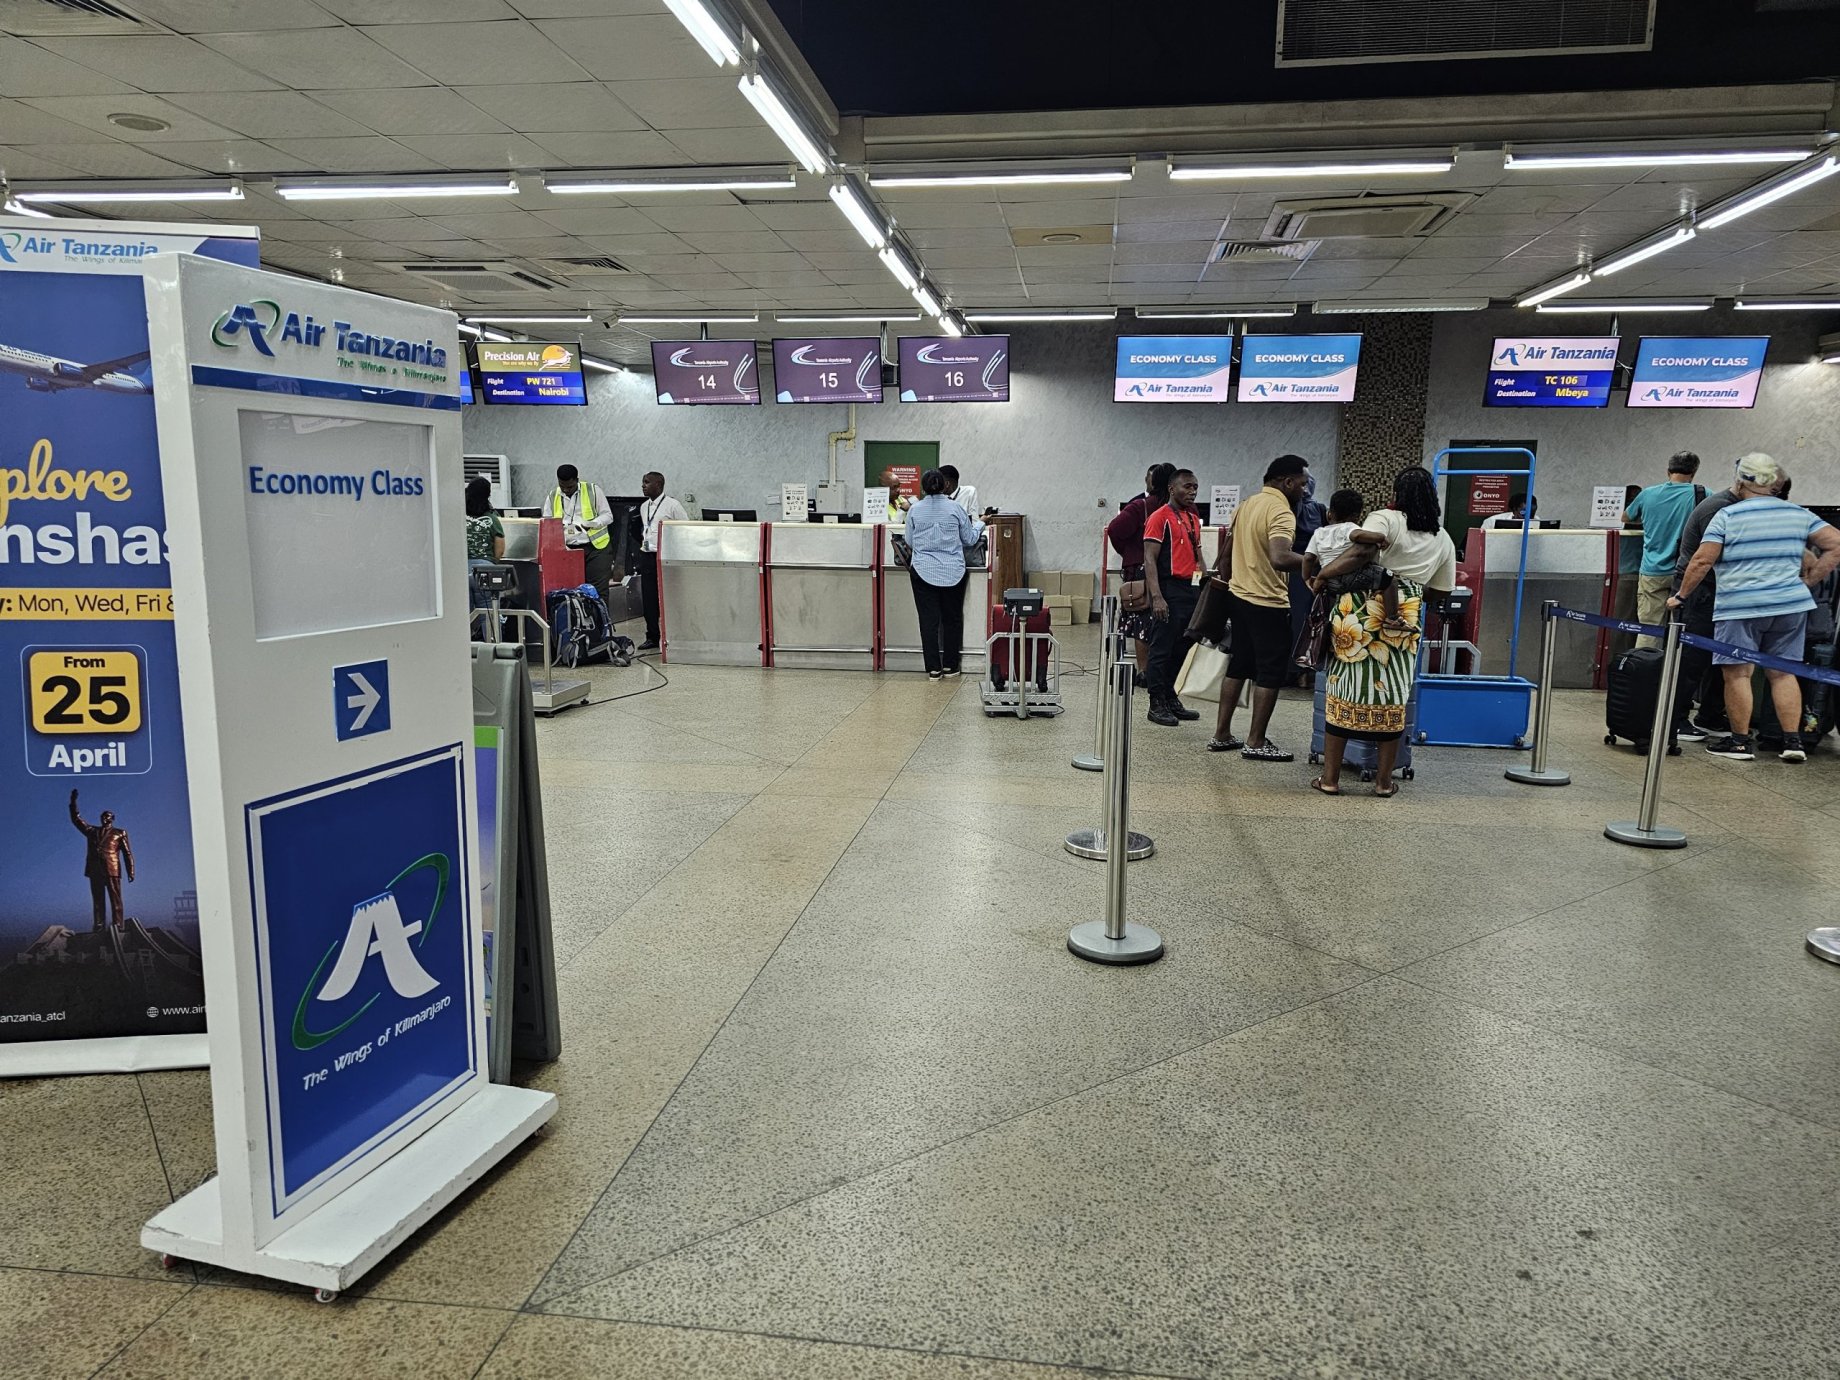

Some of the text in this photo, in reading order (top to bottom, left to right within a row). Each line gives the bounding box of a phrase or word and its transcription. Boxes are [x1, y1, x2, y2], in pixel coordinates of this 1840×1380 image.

[23, 237, 158, 257] Air Tanzania
[280, 311, 447, 369] Air Tanzania
[484, 351, 540, 361] Precision Air
[1255, 354, 1345, 363] ECONOMY CLASS
[1524, 346, 1616, 360] Air Tanzania
[1130, 355, 1217, 364] ECONOMY CLASS
[1651, 357, 1749, 366] ECONOMY CLASS
[487, 377, 556, 386] Flight PW 721
[698, 374, 717, 390] 14
[819, 372, 839, 388] 15
[944, 371, 964, 387] 16
[1494, 376, 1579, 387] Flight TC 106
[539, 388, 569, 396] Nairobi
[1147, 384, 1213, 393] Air Tanzania
[1272, 384, 1340, 393] Air Tanzania
[1555, 388, 1589, 399] Mbeya
[1665, 388, 1740, 397] Air Tanzania
[249, 466, 424, 501] Economy Class
[19, 594, 69, 615] Mon,
[75, 594, 130, 616] Wed,
[137, 594, 160, 611] Fri
[64, 656, 105, 668] From
[42, 675, 131, 725] 25
[48, 742, 126, 773] April
[303, 995, 451, 1091] The Wings of Kilimanjaro
